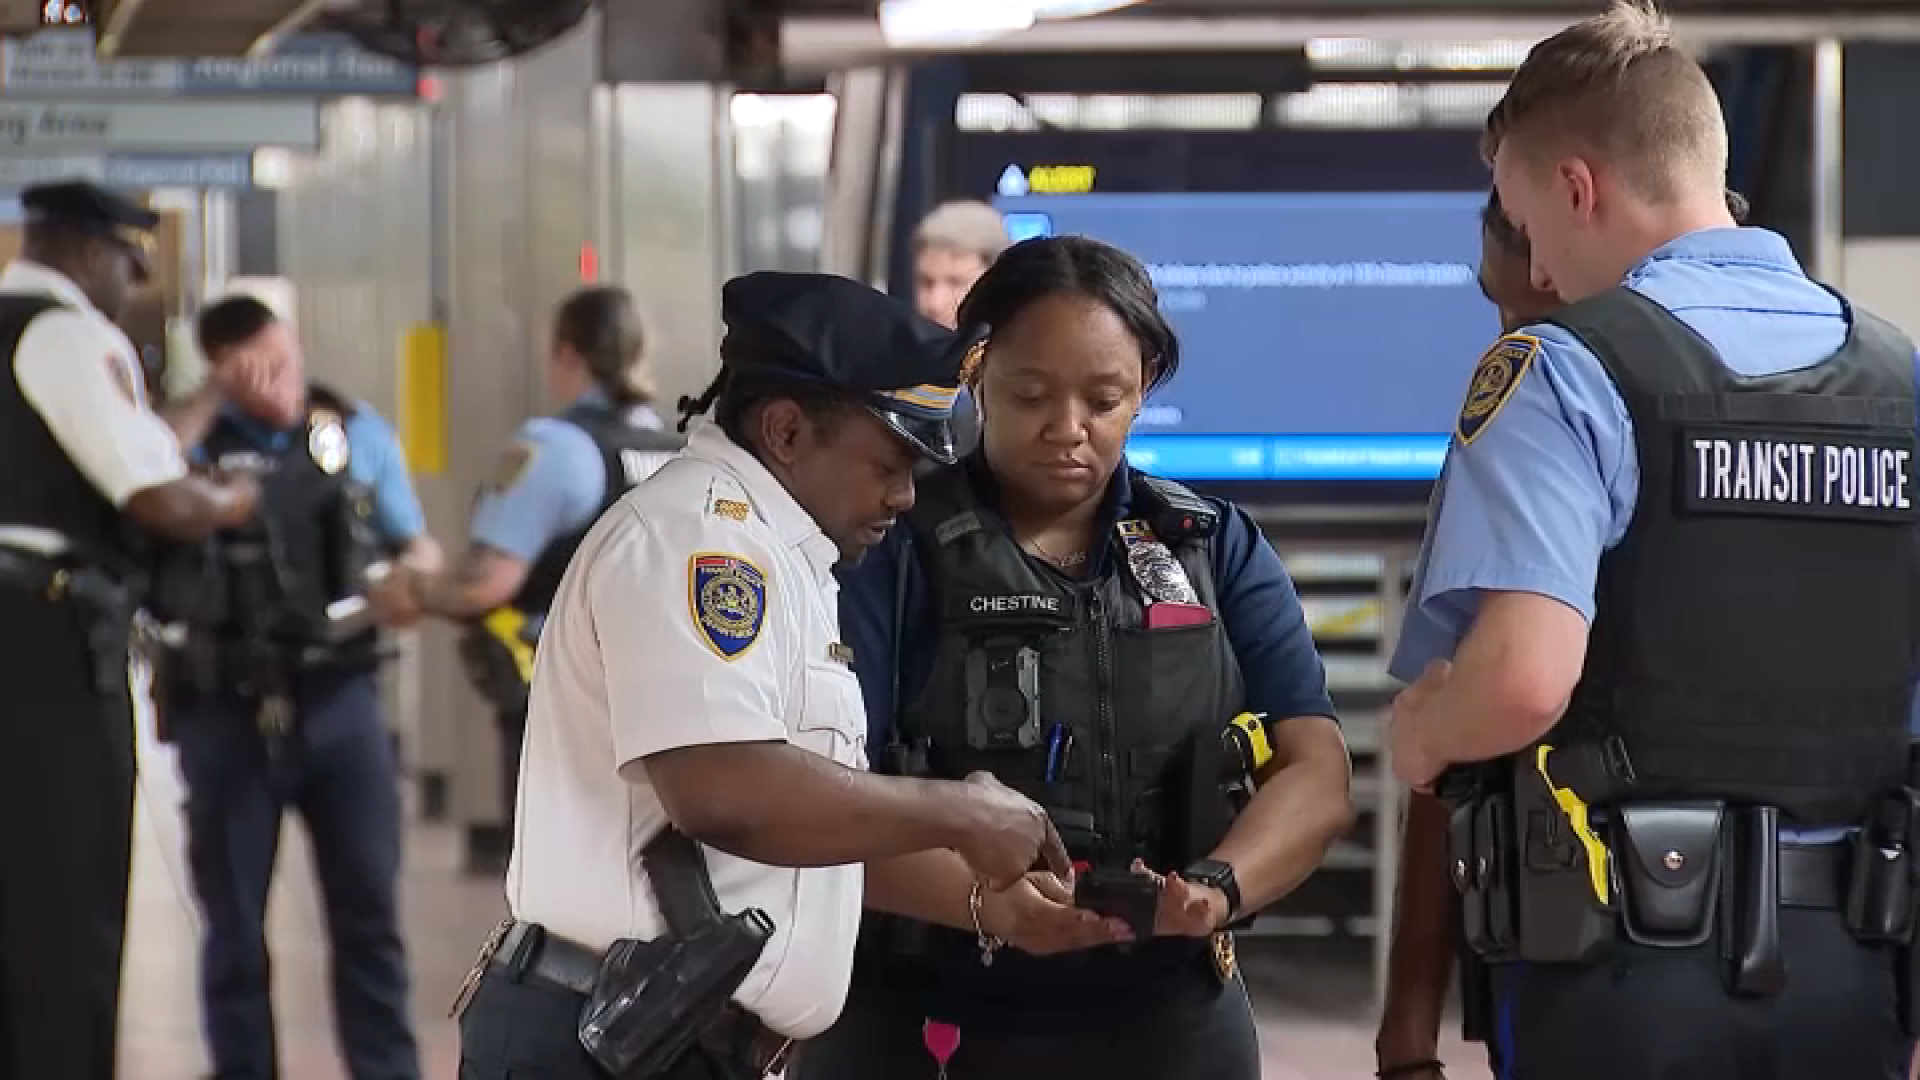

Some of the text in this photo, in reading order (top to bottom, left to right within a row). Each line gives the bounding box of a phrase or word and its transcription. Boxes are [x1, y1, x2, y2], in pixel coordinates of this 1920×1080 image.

[1693, 439, 1910, 508] TRANSIT POLICE
[970, 595, 1059, 611] CHESTINE
